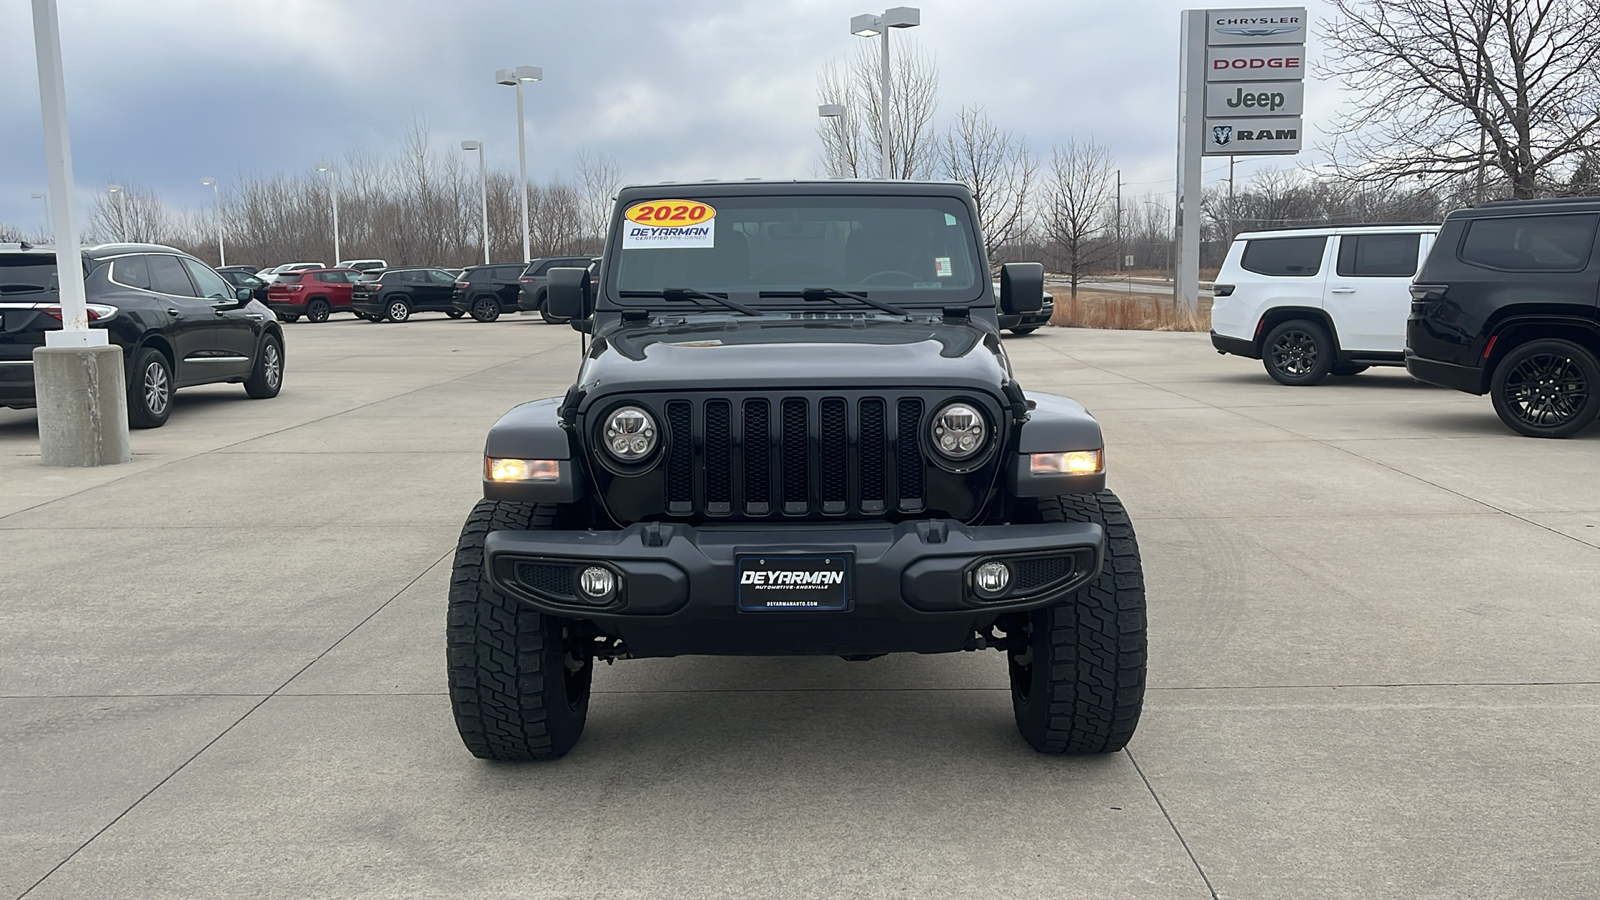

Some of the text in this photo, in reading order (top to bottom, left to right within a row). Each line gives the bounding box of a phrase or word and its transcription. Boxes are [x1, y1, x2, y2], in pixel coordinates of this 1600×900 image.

[1216, 17, 1299, 25] CHRYSLER
[1213, 57, 1300, 70] DODGE
[1226, 87, 1285, 112] Jeep
[1237, 129, 1297, 141] RAM
[635, 206, 706, 220] 2020
[630, 228, 709, 236] DEYARMAN
[740, 570, 844, 585] DEYARMAN
